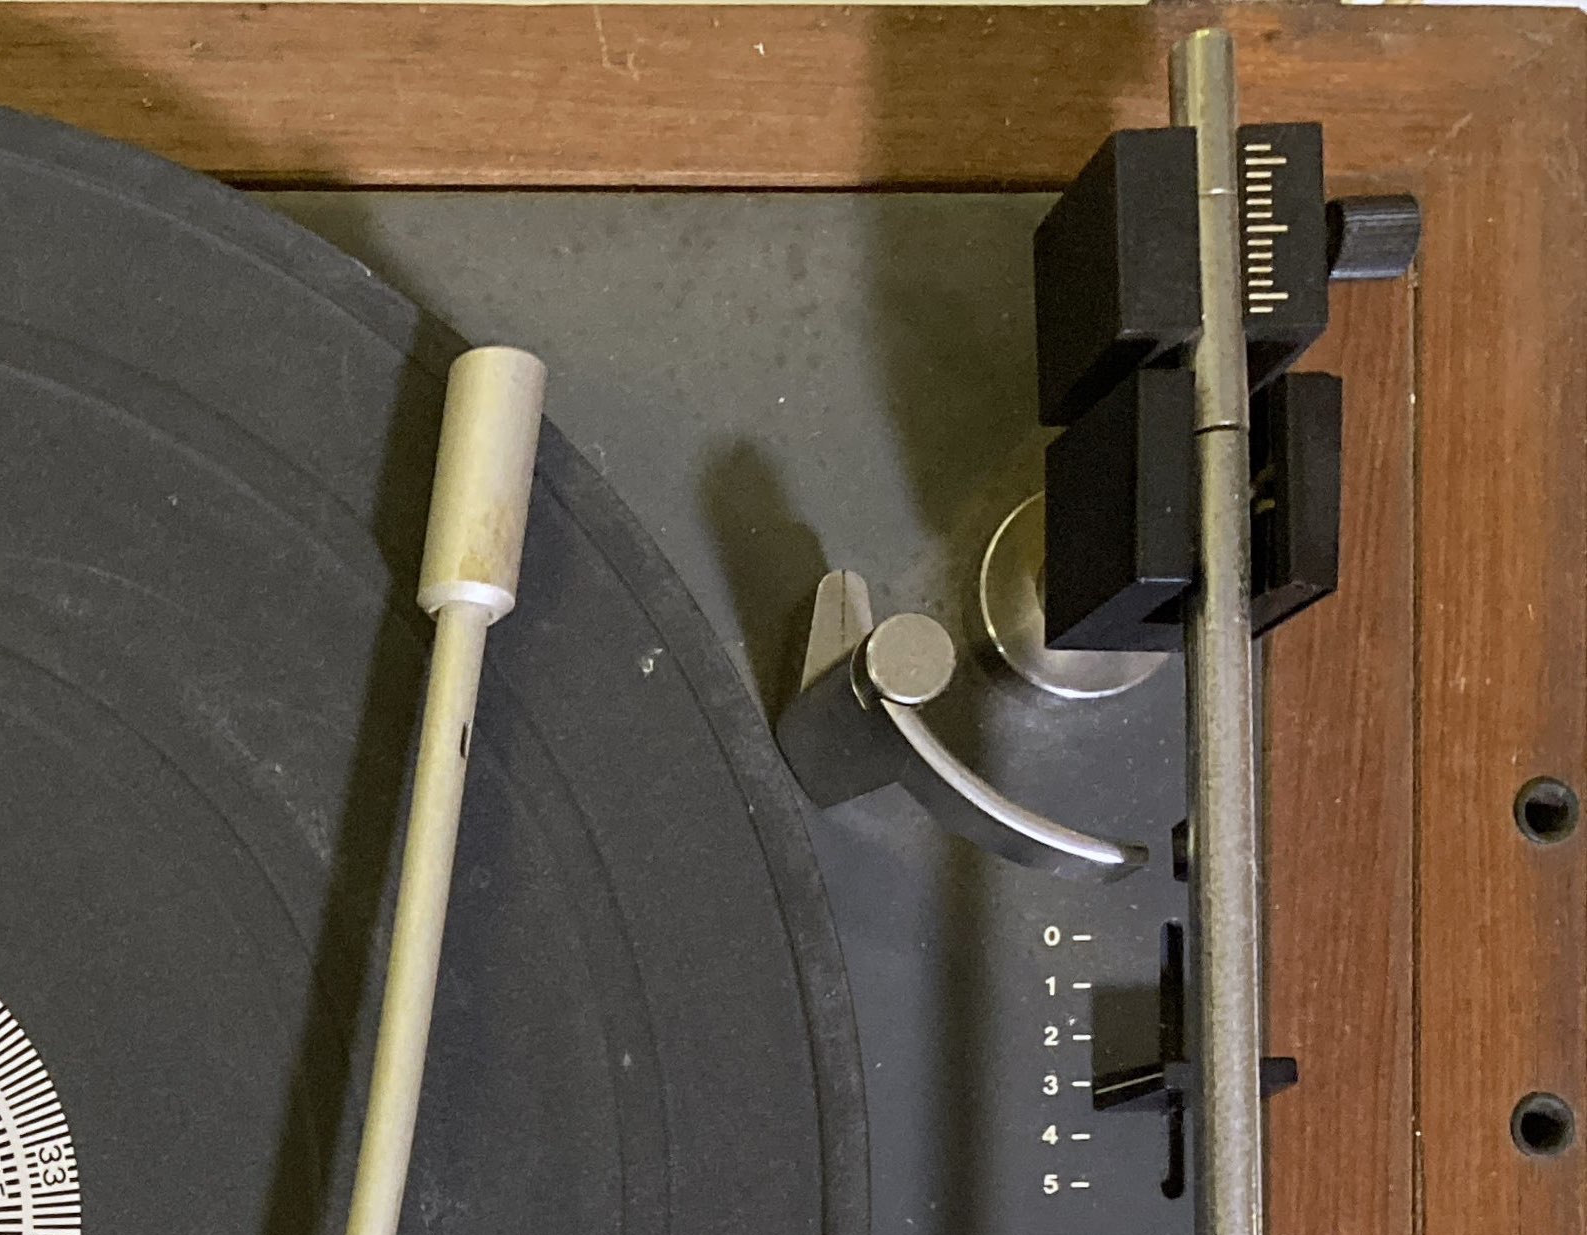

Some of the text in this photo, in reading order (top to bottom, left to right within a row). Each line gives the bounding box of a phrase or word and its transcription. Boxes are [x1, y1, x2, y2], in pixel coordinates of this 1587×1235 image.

[1043, 925, 1061, 947] 0
[1044, 976, 1056, 996] 1
[1043, 1026, 1060, 1046] 2
[1042, 1075, 1059, 1096] 3
[1041, 1125, 1059, 1145] 4
[38, 1145, 67, 1187] 33
[1042, 1174, 1059, 1194] 5
